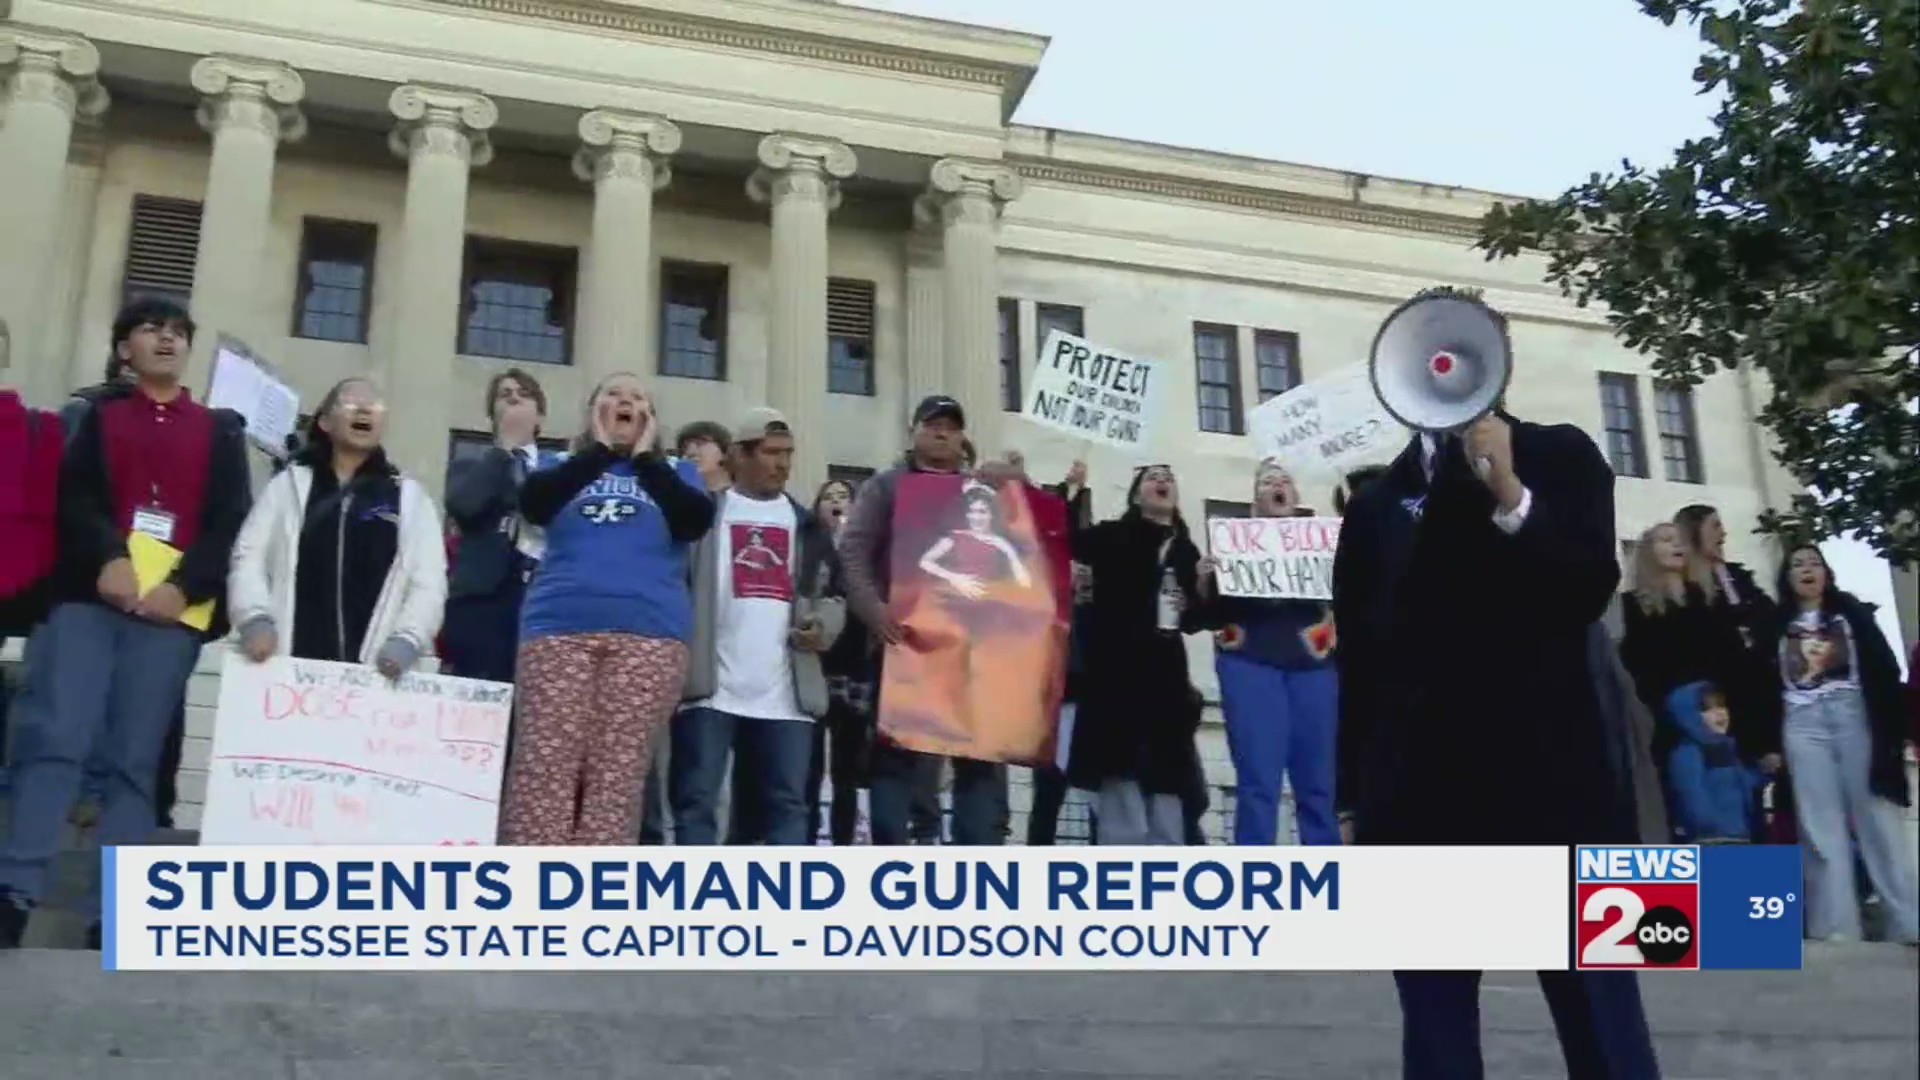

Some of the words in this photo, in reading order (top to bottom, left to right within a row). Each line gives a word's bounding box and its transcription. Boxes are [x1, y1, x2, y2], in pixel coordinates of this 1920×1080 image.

[1053, 340, 1151, 397] PROTECT
[1032, 390, 1069, 423] NOT
[1067, 381, 1098, 402] OUR
[1214, 521, 1267, 554] OUR
[1220, 558, 1283, 594] YOUR
